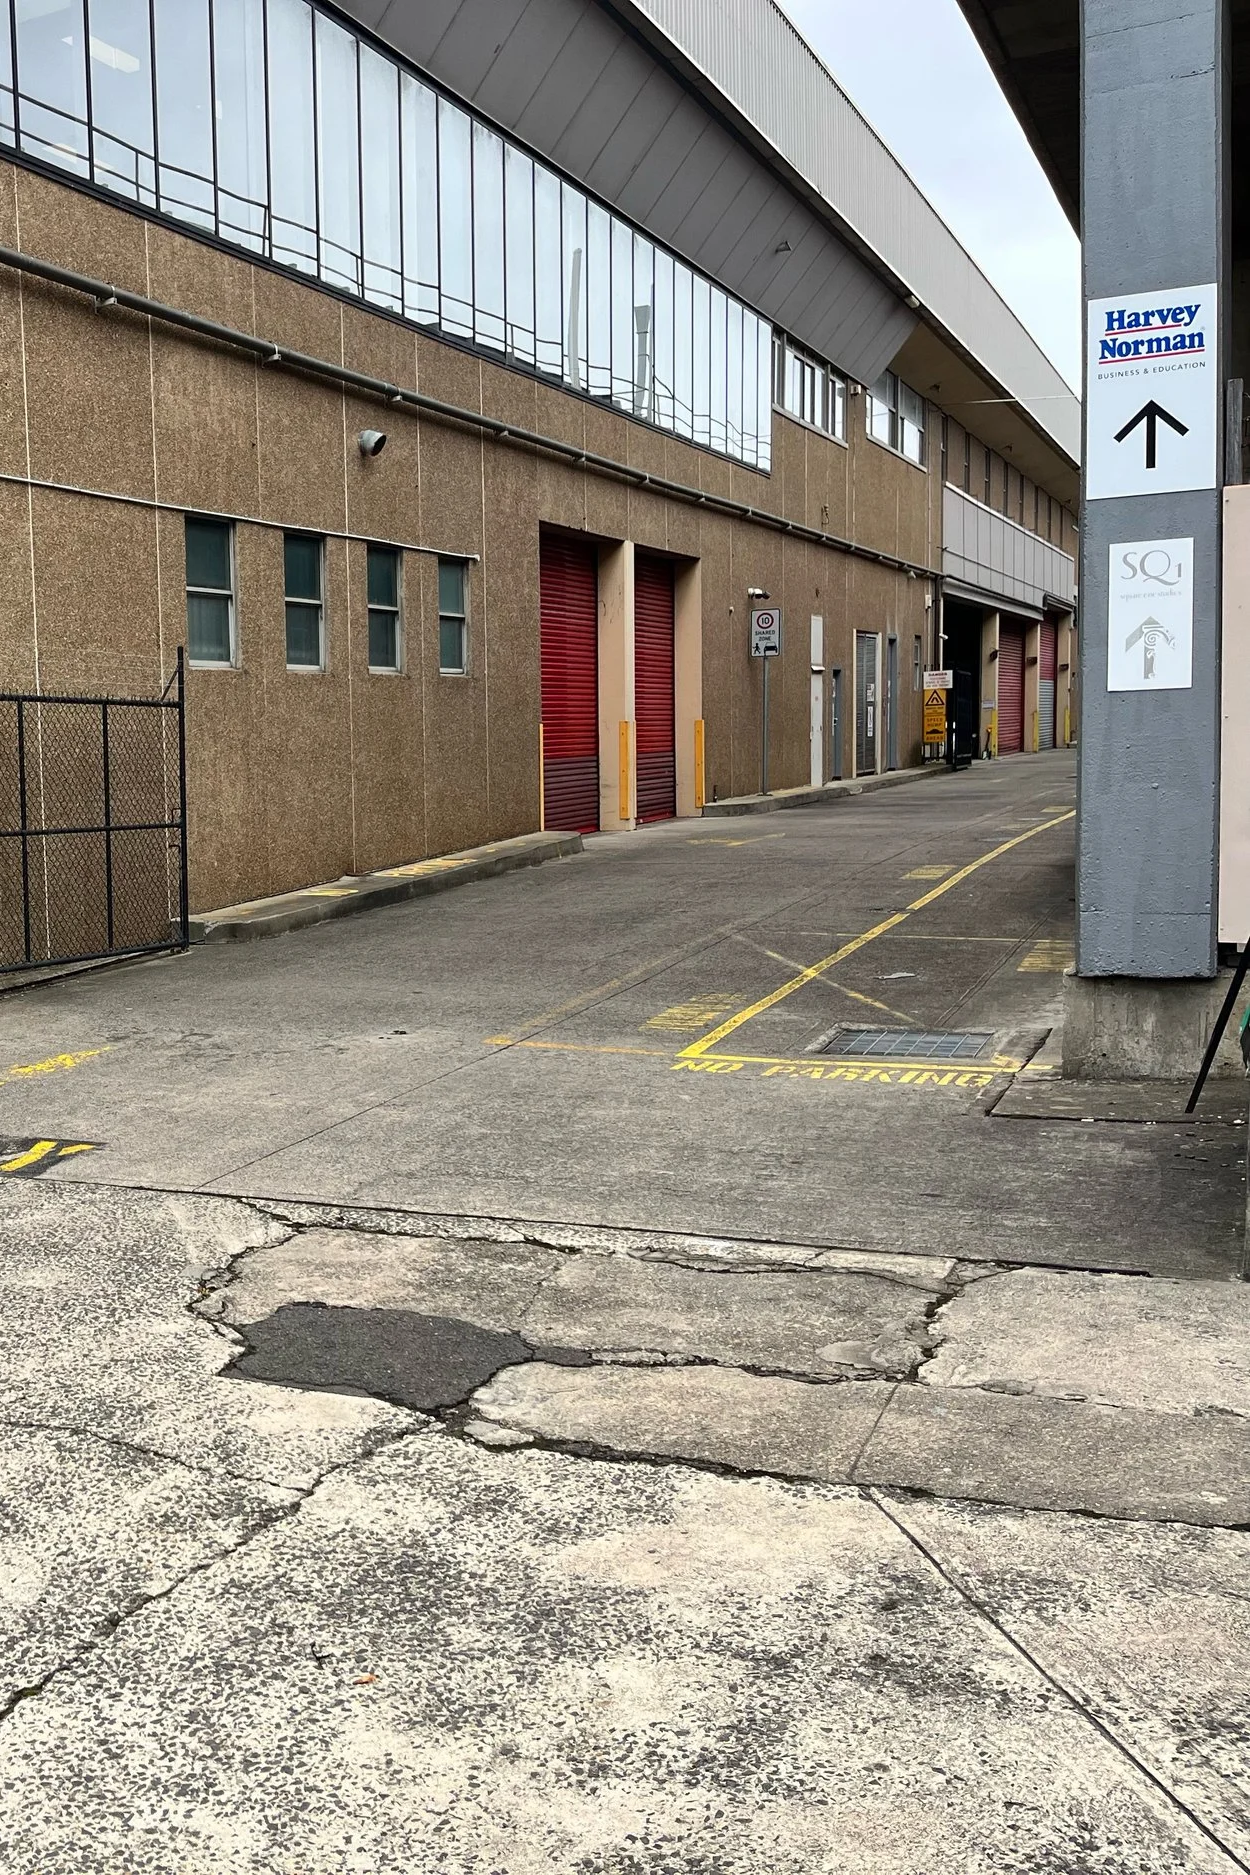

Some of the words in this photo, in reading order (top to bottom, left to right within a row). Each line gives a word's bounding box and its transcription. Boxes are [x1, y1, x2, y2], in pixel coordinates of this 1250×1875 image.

[1105, 304, 1201, 332] Harvey
[1099, 331, 1205, 360] Norman
[1097, 369, 1140, 380] BUSINESS
[1152, 361, 1206, 374] EDUCATION
[1120, 549, 1182, 586] SQ1
[761, 616, 770, 625] 10
[669, 1059, 746, 1074] NO
[760, 1064, 995, 1088] PARKING
